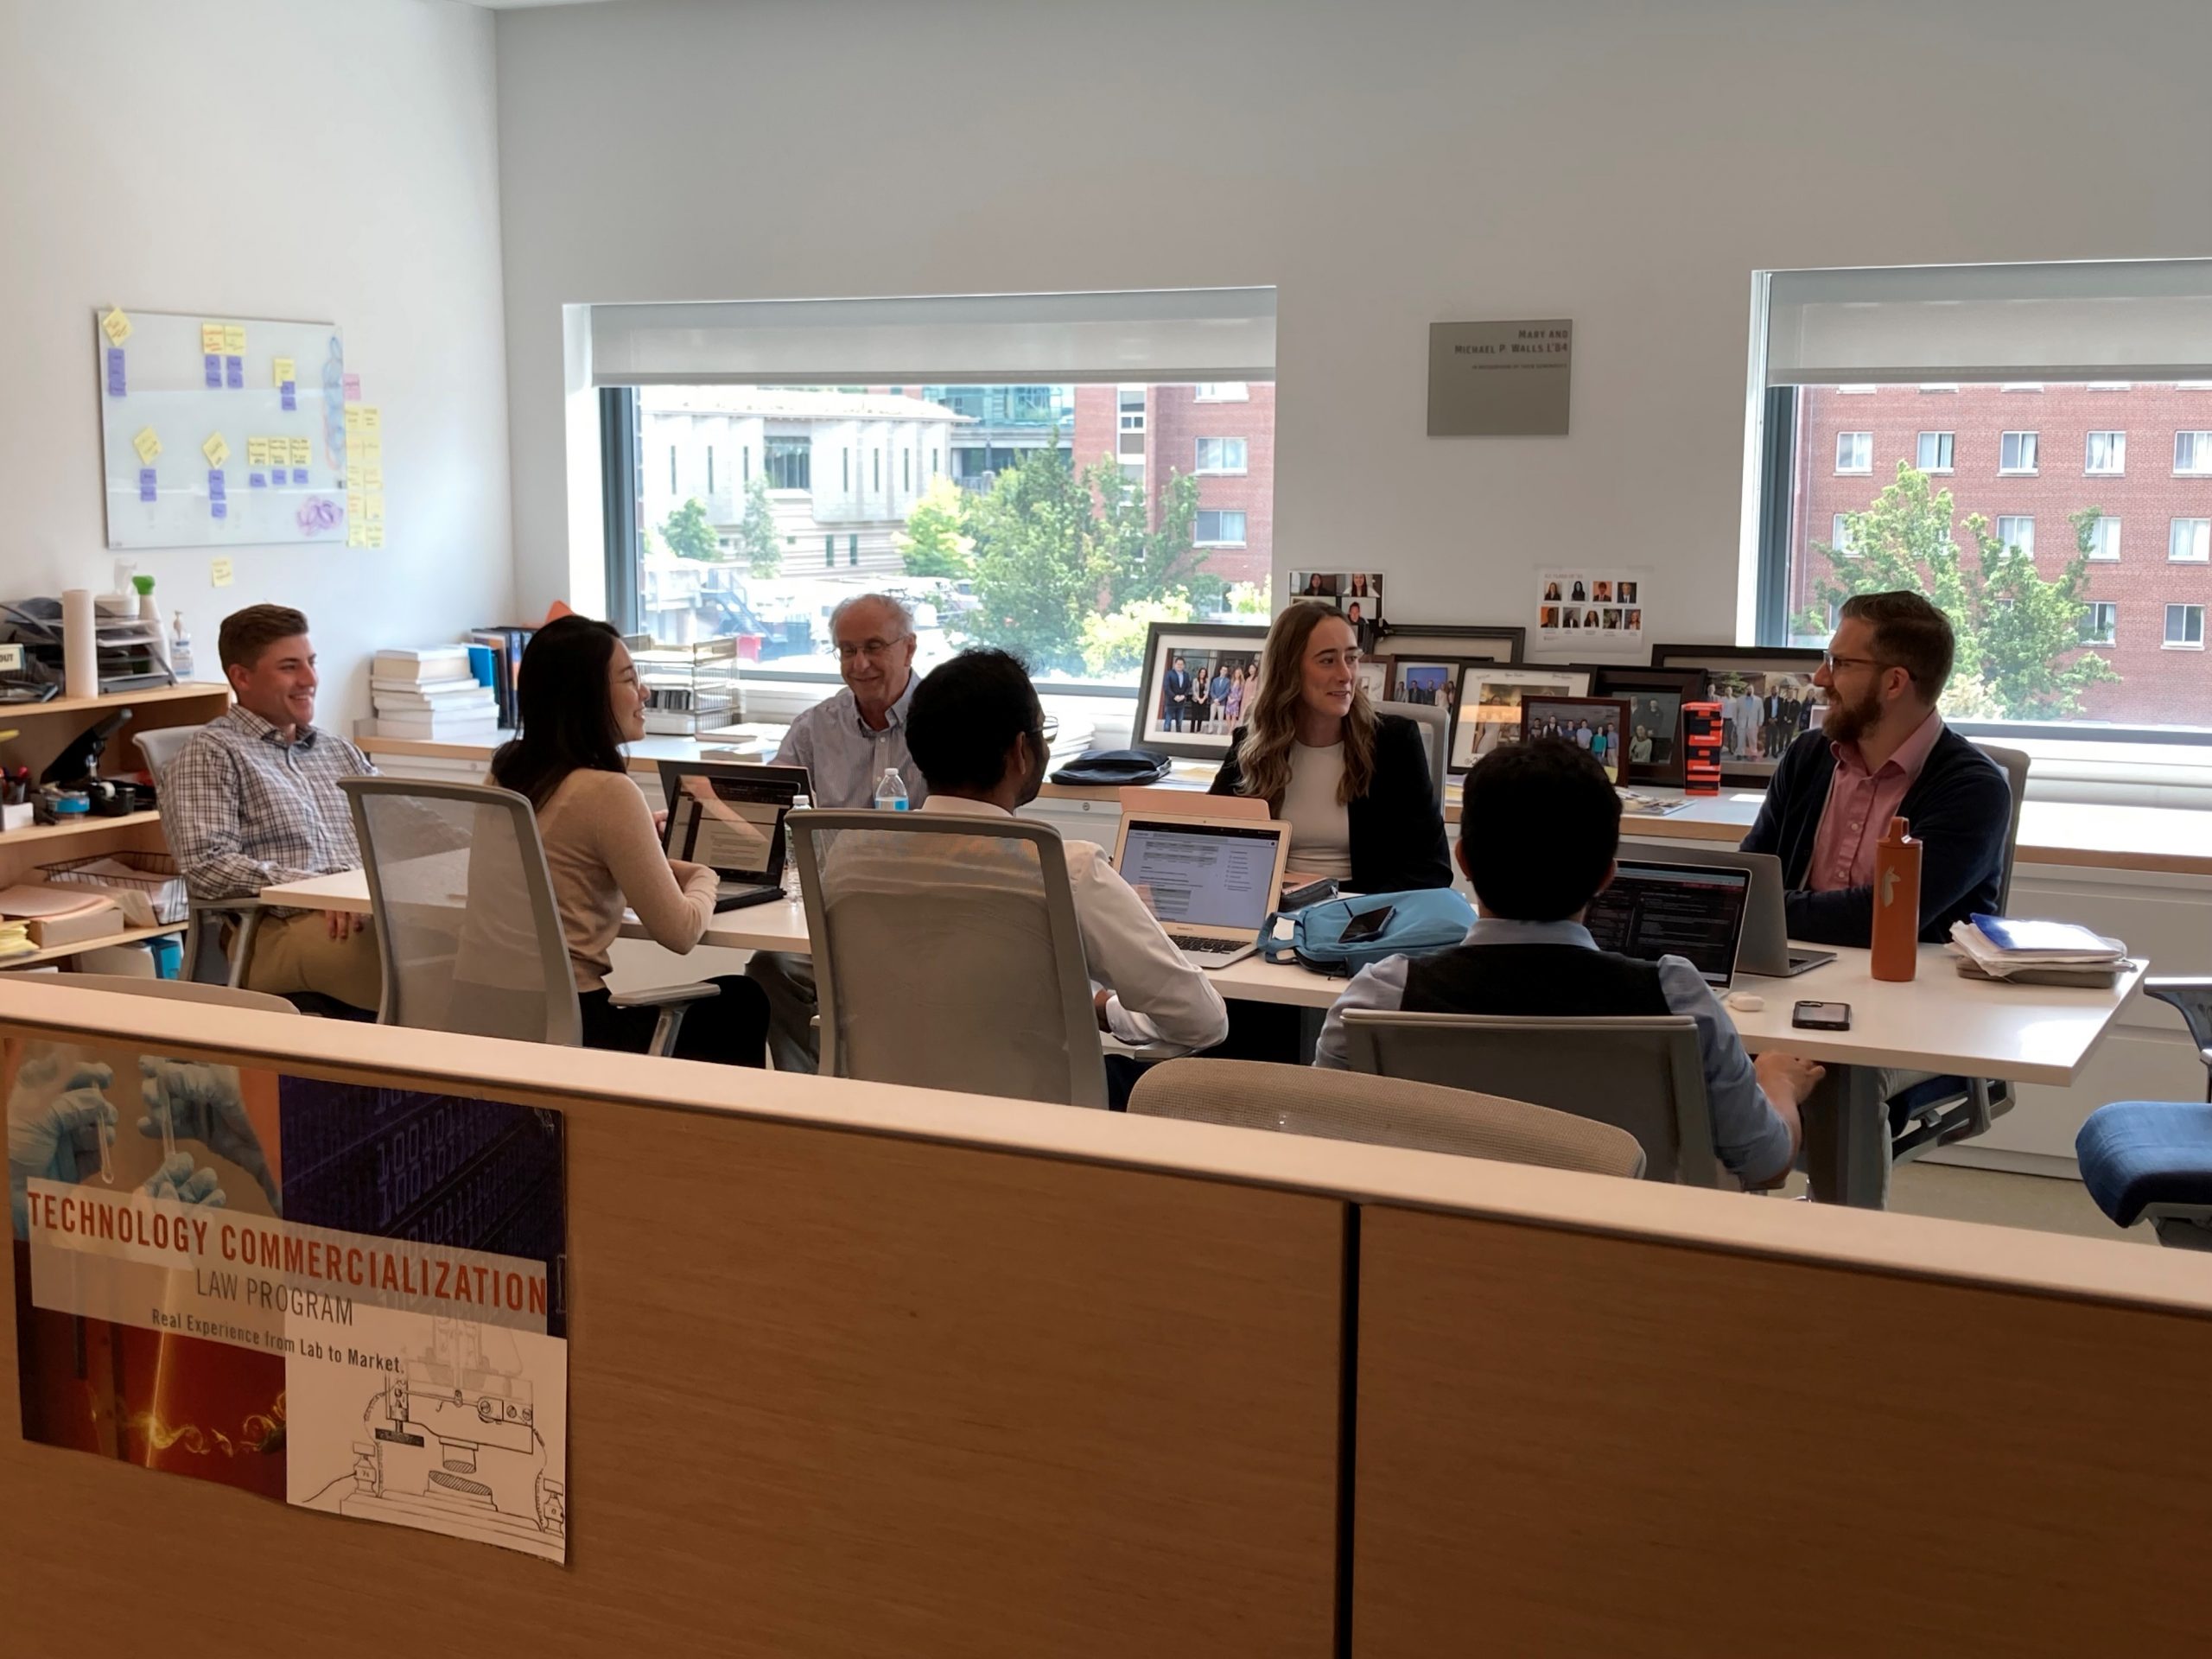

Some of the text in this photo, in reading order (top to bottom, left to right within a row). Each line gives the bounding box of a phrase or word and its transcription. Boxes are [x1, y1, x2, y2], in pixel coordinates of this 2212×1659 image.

[1454, 345, 1496, 354] MICHAEL
[1511, 343, 1544, 353] WALLS
[1518, 330, 1545, 339] MARY
[28, 1192, 547, 1315] TECHNOLOGY COMMERCIALIZATION
[196, 1268, 353, 1326] LAW PROGRAM
[152, 1308, 404, 1374] Real Experience from Lab to Market.
